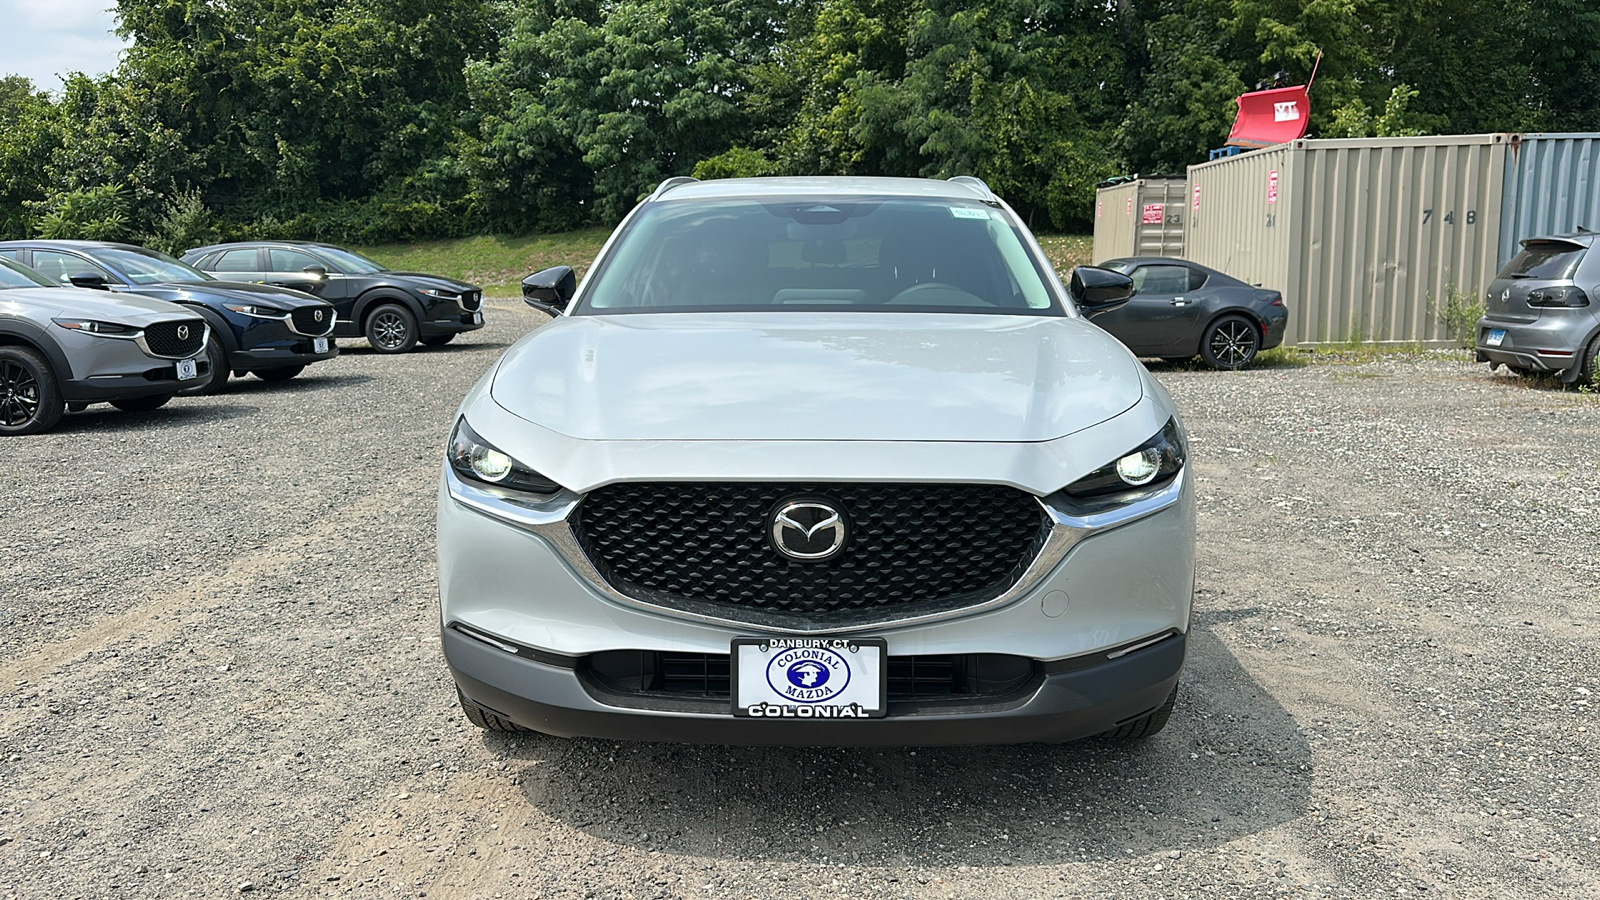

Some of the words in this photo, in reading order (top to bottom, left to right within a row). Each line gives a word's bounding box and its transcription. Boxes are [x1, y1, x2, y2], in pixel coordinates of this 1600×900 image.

[1166, 214, 1180, 224] 23
[769, 638, 830, 649] DANBURY,
[833, 638, 850, 648] CT
[777, 649, 841, 670] COLONIAL
[785, 685, 834, 699] MAZDA
[747, 704, 870, 718] COLONIAL
